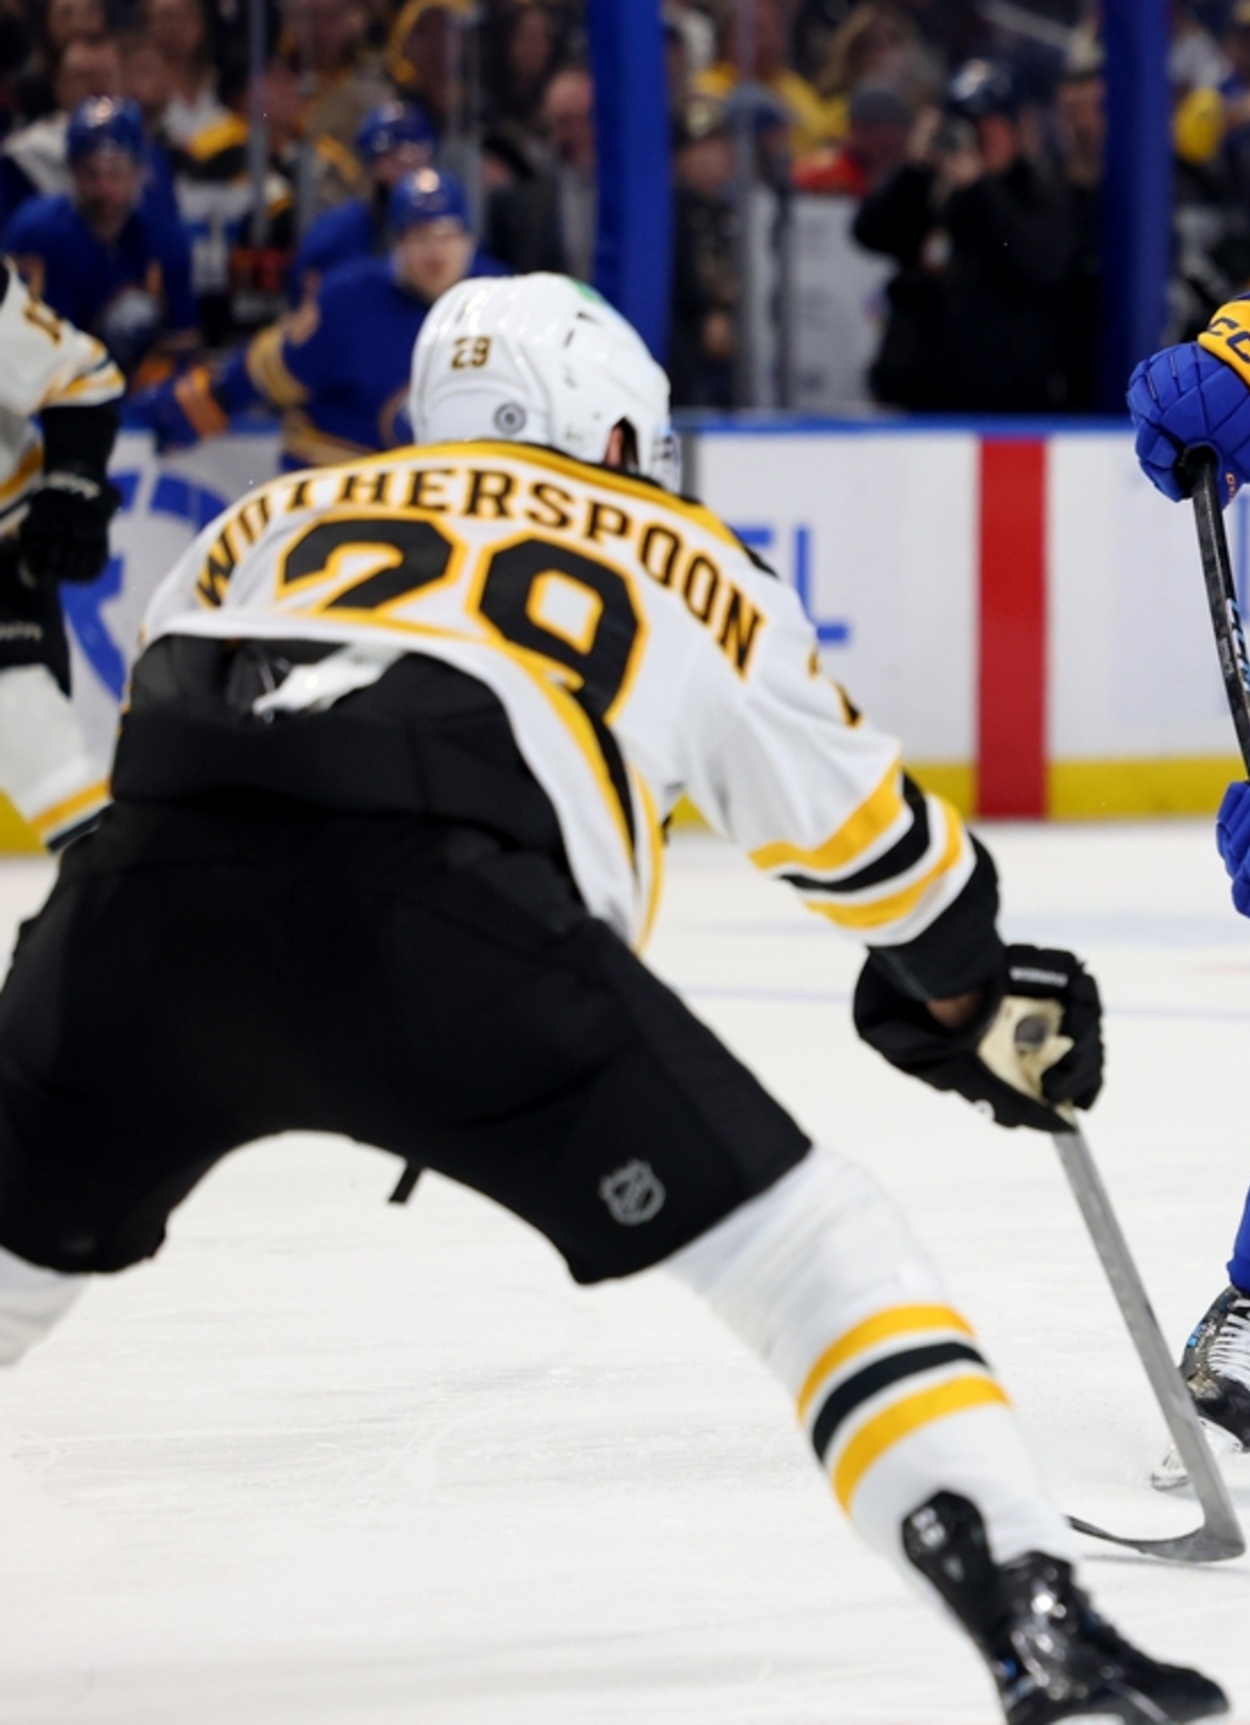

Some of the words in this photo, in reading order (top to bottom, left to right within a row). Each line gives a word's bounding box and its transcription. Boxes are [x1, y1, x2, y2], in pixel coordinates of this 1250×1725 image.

[451, 334, 492, 370] 29
[194, 466, 768, 682] WOTHERSPOON
[275, 507, 648, 727] 29
